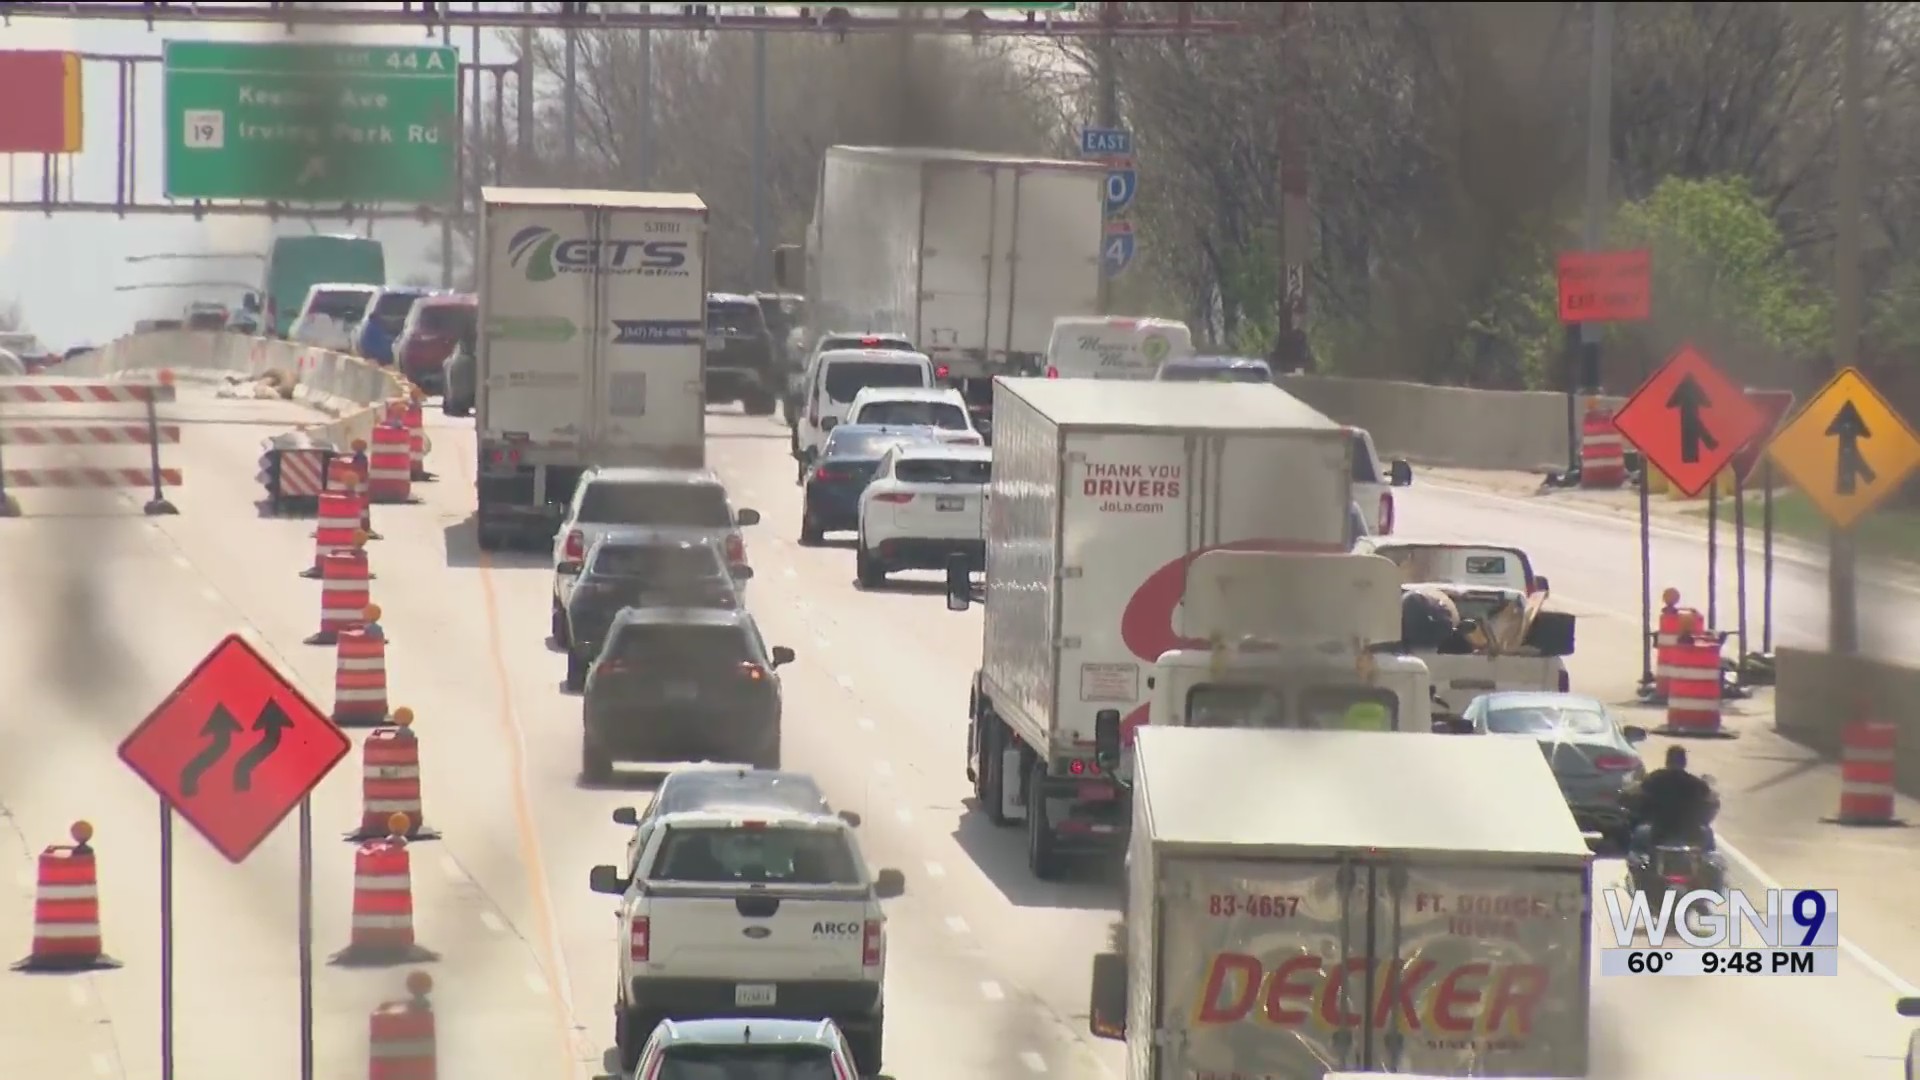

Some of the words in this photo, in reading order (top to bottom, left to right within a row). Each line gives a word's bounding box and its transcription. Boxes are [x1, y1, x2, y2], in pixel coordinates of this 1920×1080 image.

[386, 52, 417, 69] 44
[426, 52, 443, 69] A
[341, 86, 388, 108] Ave
[193, 124, 214, 141] 19
[408, 124, 438, 144] Rd
[1087, 133, 1125, 150] EAST
[555, 239, 688, 268] GTS
[1085, 463, 1142, 477] THANK
[1148, 464, 1181, 479] YOU
[1083, 479, 1181, 498] DRIVERS
[1209, 895, 1300, 918] 83-4657
[1415, 892, 1447, 913] FT.
[812, 920, 860, 936] ARCO
[1194, 953, 1551, 1035] DECKER
